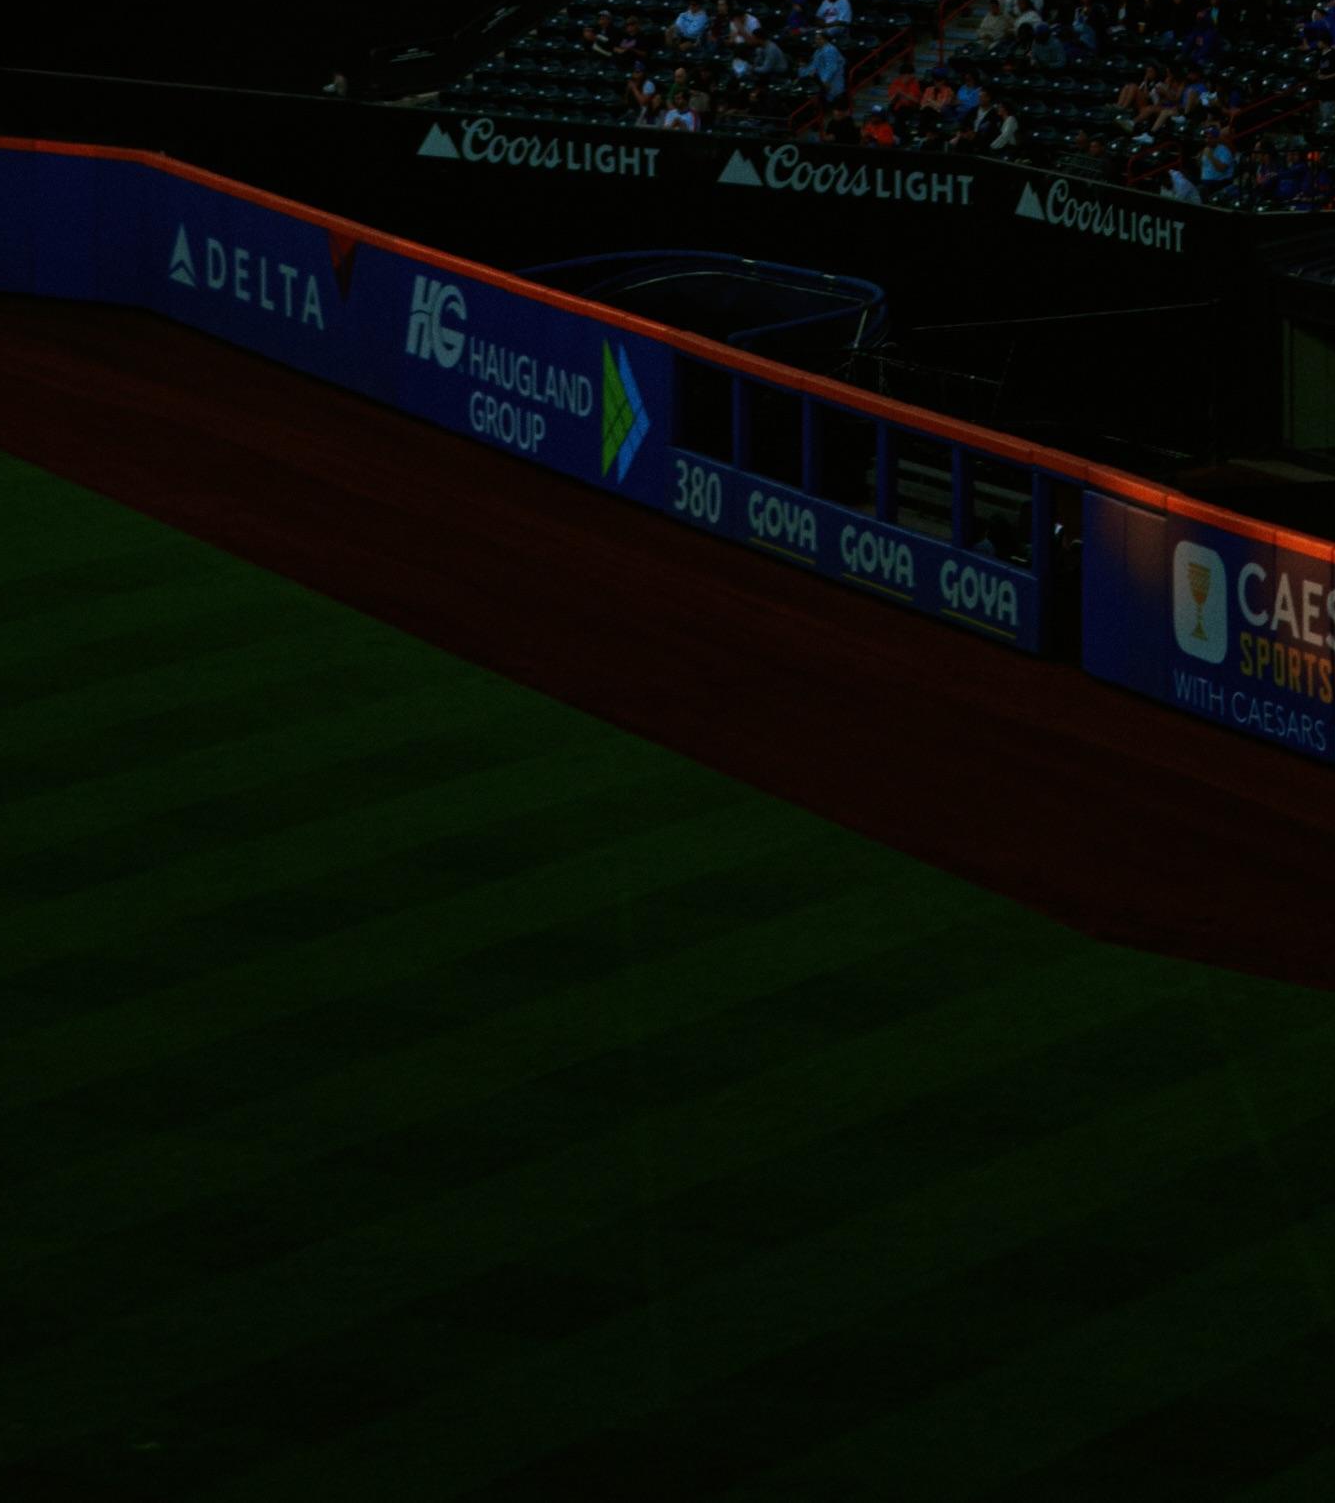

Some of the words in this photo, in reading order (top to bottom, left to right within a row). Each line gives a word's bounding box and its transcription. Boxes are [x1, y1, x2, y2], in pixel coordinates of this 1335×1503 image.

[460, 117, 563, 170] Coors
[566, 141, 660, 179] LIGHT
[764, 144, 871, 197] Coors
[874, 167, 974, 208] LIGHT
[1044, 177, 1117, 240] Coors
[1118, 205, 1186, 255] LIGHT
[207, 237, 325, 331] DELTA
[405, 275, 468, 368] HG
[469, 336, 593, 417] HAUGLAND
[469, 391, 546, 453] GROUP
[674, 459, 723, 524] 380
[748, 490, 818, 553] GOYA
[839, 524, 915, 589] GOYA
[939, 559, 1019, 627] GOYA
[1173, 667, 1226, 717] WITH
[1231, 691, 1327, 752] CAESARS
